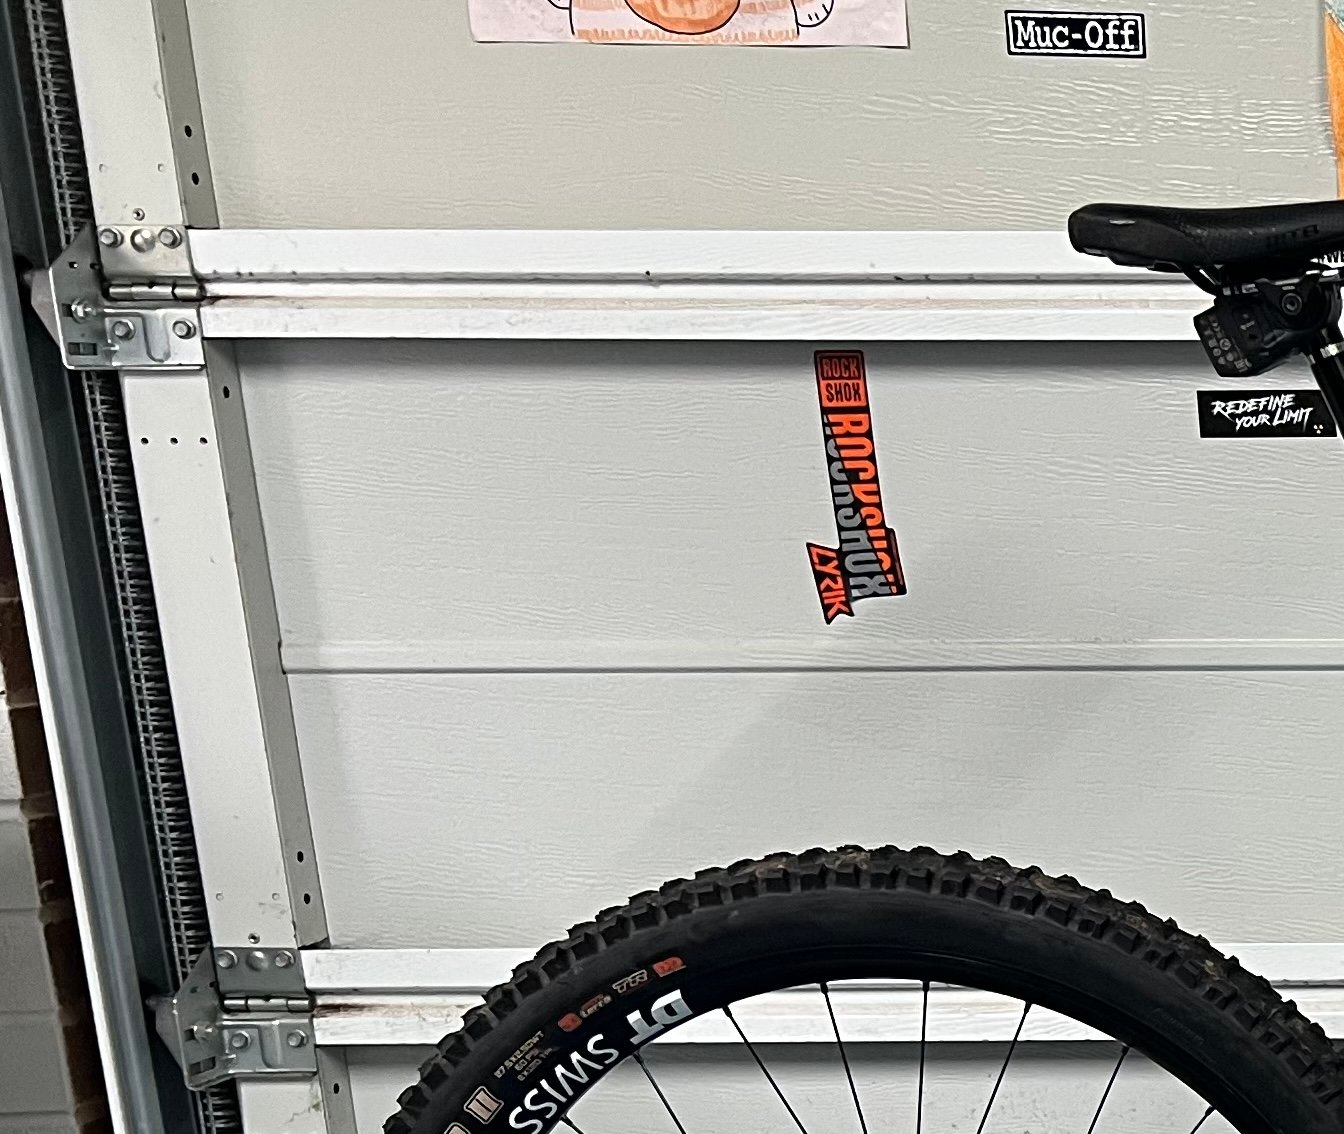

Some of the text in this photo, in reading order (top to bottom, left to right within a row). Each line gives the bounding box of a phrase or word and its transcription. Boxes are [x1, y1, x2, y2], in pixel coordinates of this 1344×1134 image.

[1015, 18, 1136, 50] Muc-Off
[822, 357, 859, 379] ROCK
[825, 382, 862, 403] SHOX
[1211, 394, 1296, 420] REDEFINE
[1235, 407, 1314, 432] YOUR LIMIT
[626, 989, 693, 1045] DT
